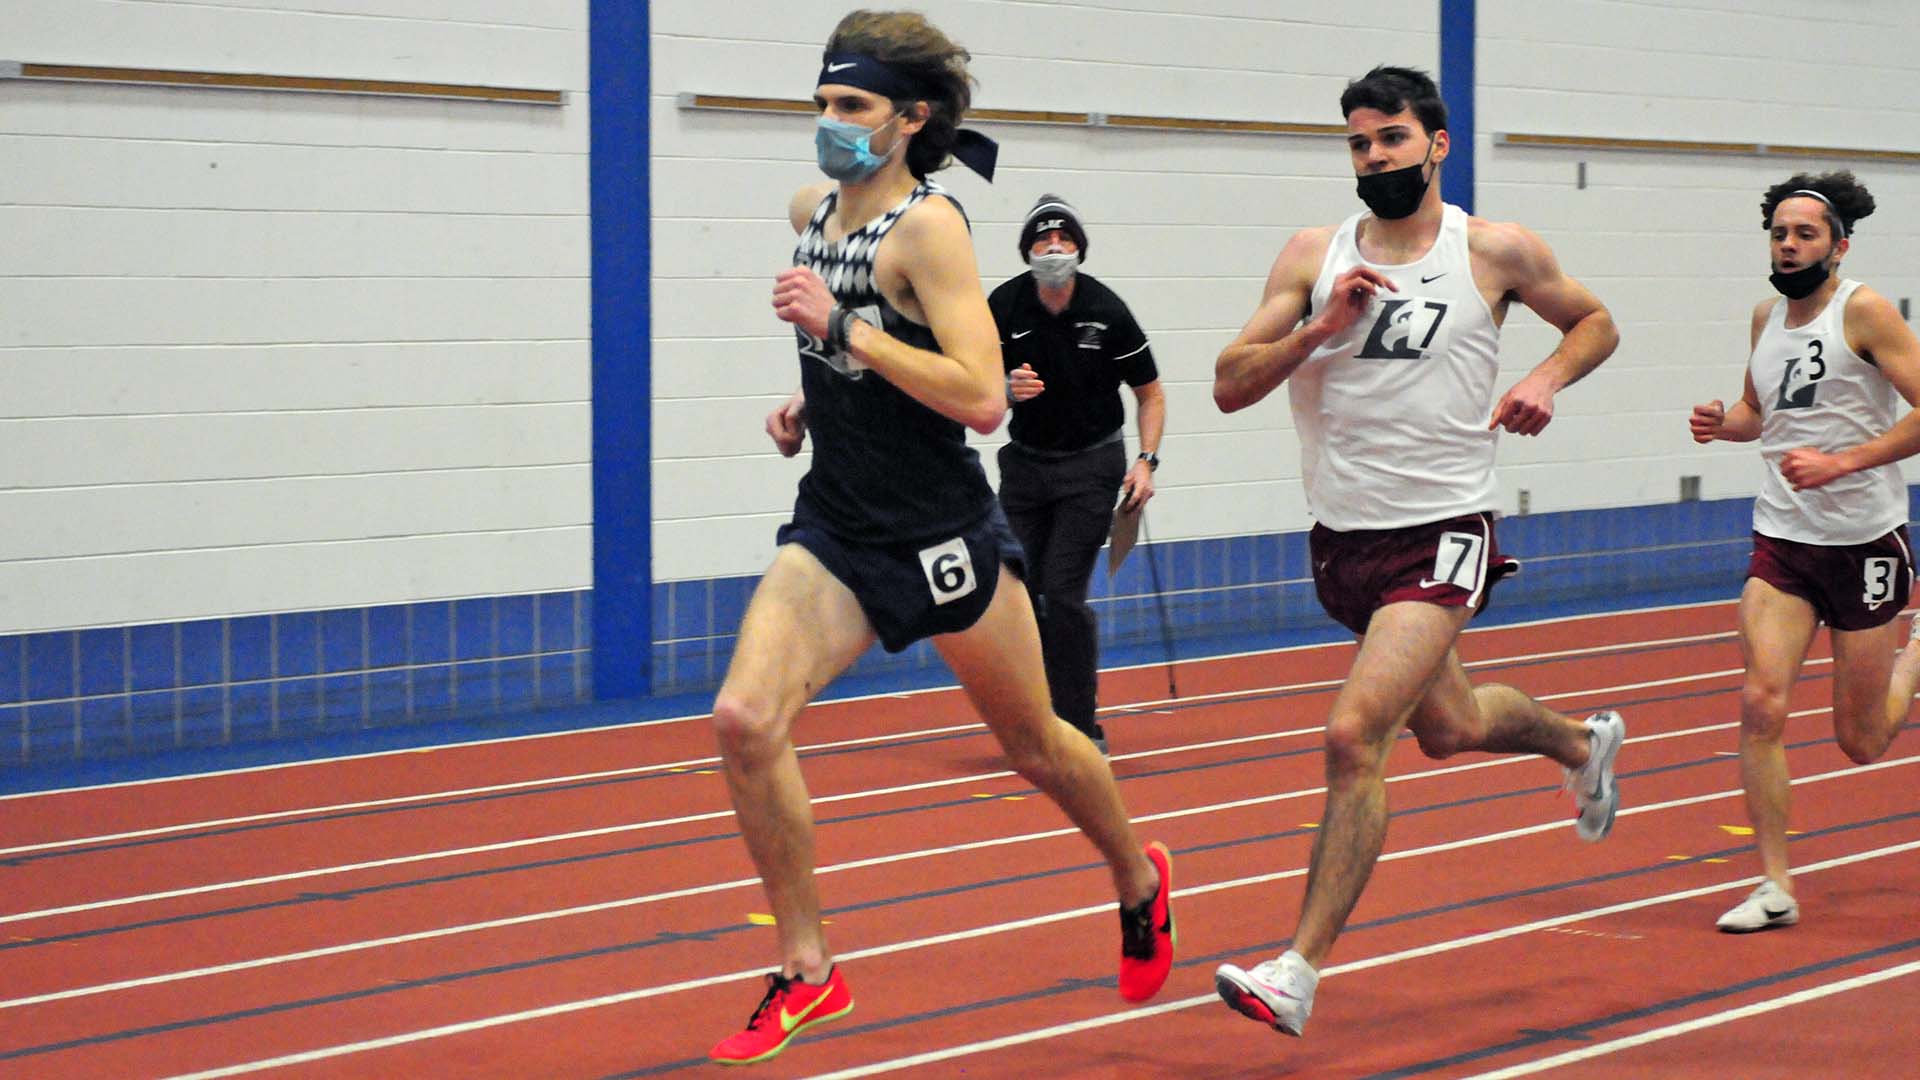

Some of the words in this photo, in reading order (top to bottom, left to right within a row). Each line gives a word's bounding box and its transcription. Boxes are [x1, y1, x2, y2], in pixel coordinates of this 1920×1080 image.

[1420, 301, 1448, 349] 7
[1808, 339, 1826, 381] 3
[931, 553, 966, 594] 6
[1447, 536, 1474, 584] 7
[1871, 560, 1890, 601] 3
